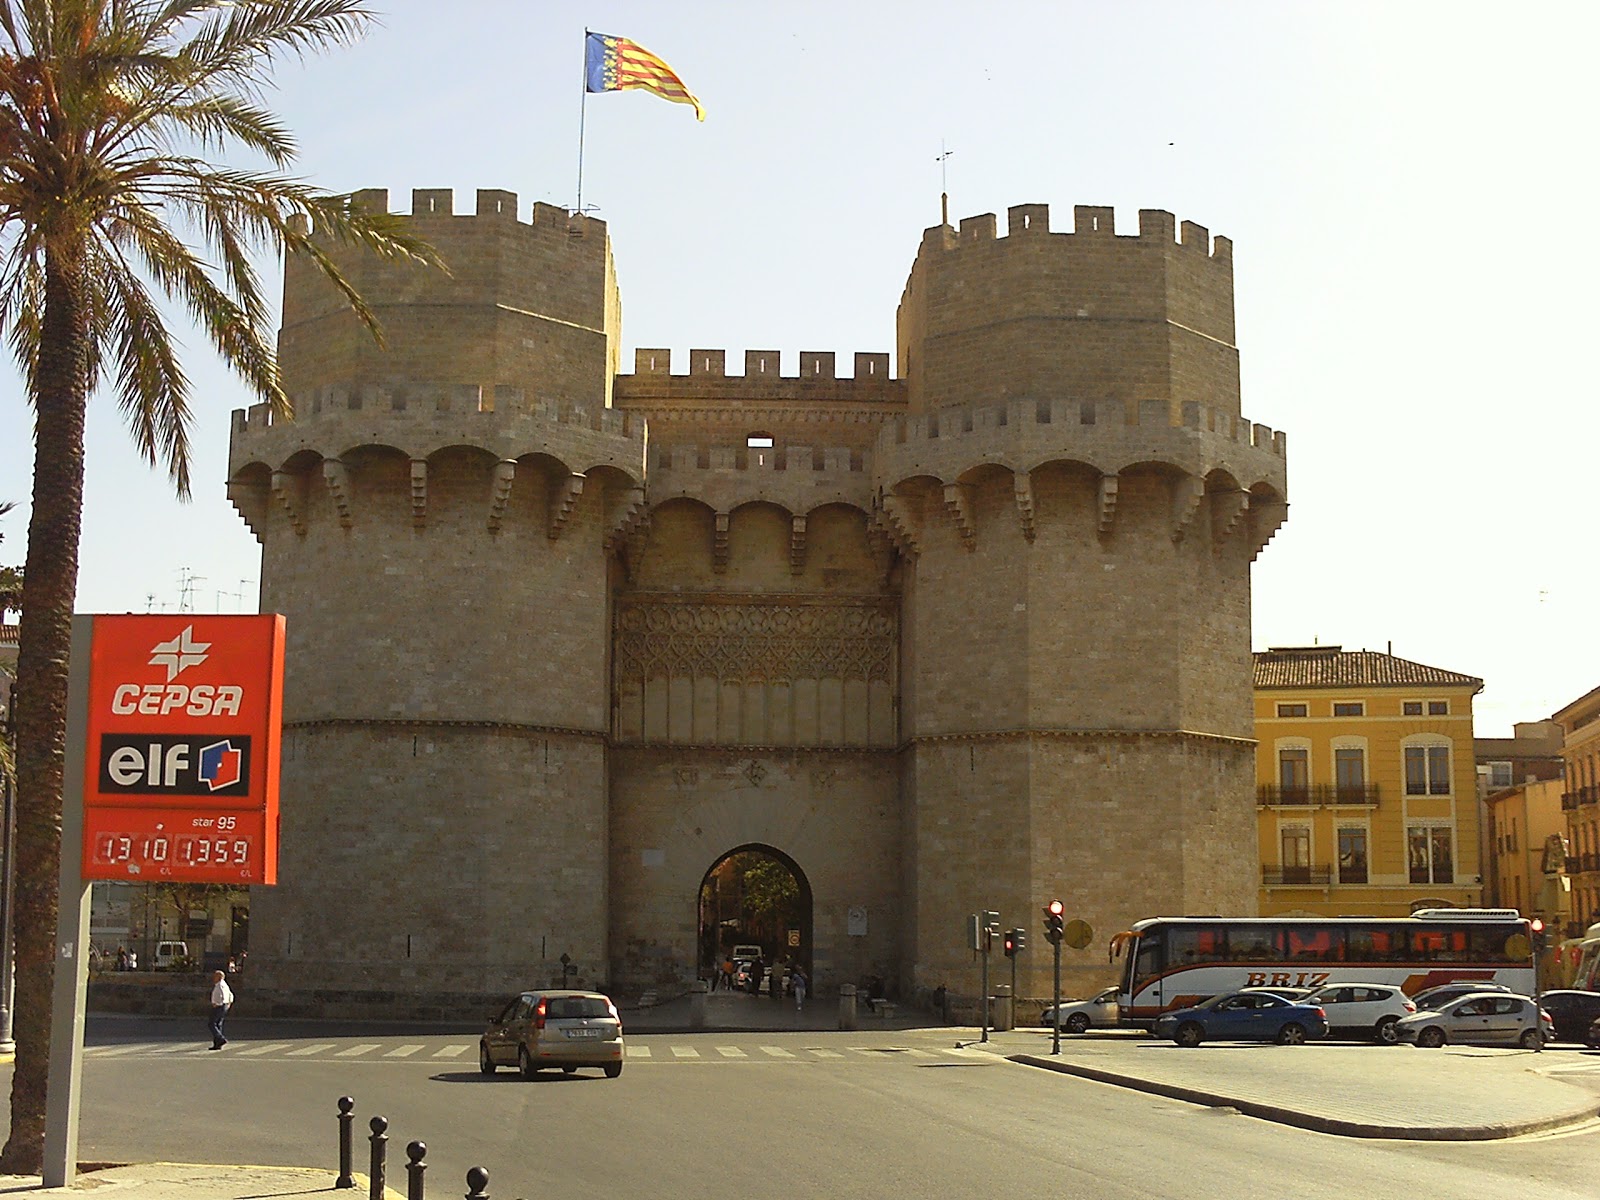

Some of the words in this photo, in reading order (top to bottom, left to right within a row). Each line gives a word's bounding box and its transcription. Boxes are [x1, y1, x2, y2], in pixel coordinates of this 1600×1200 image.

[112, 684, 243, 716] CEPSA
[108, 744, 189, 785] elf
[192, 817, 214, 827] star
[217, 816, 236, 829] 95
